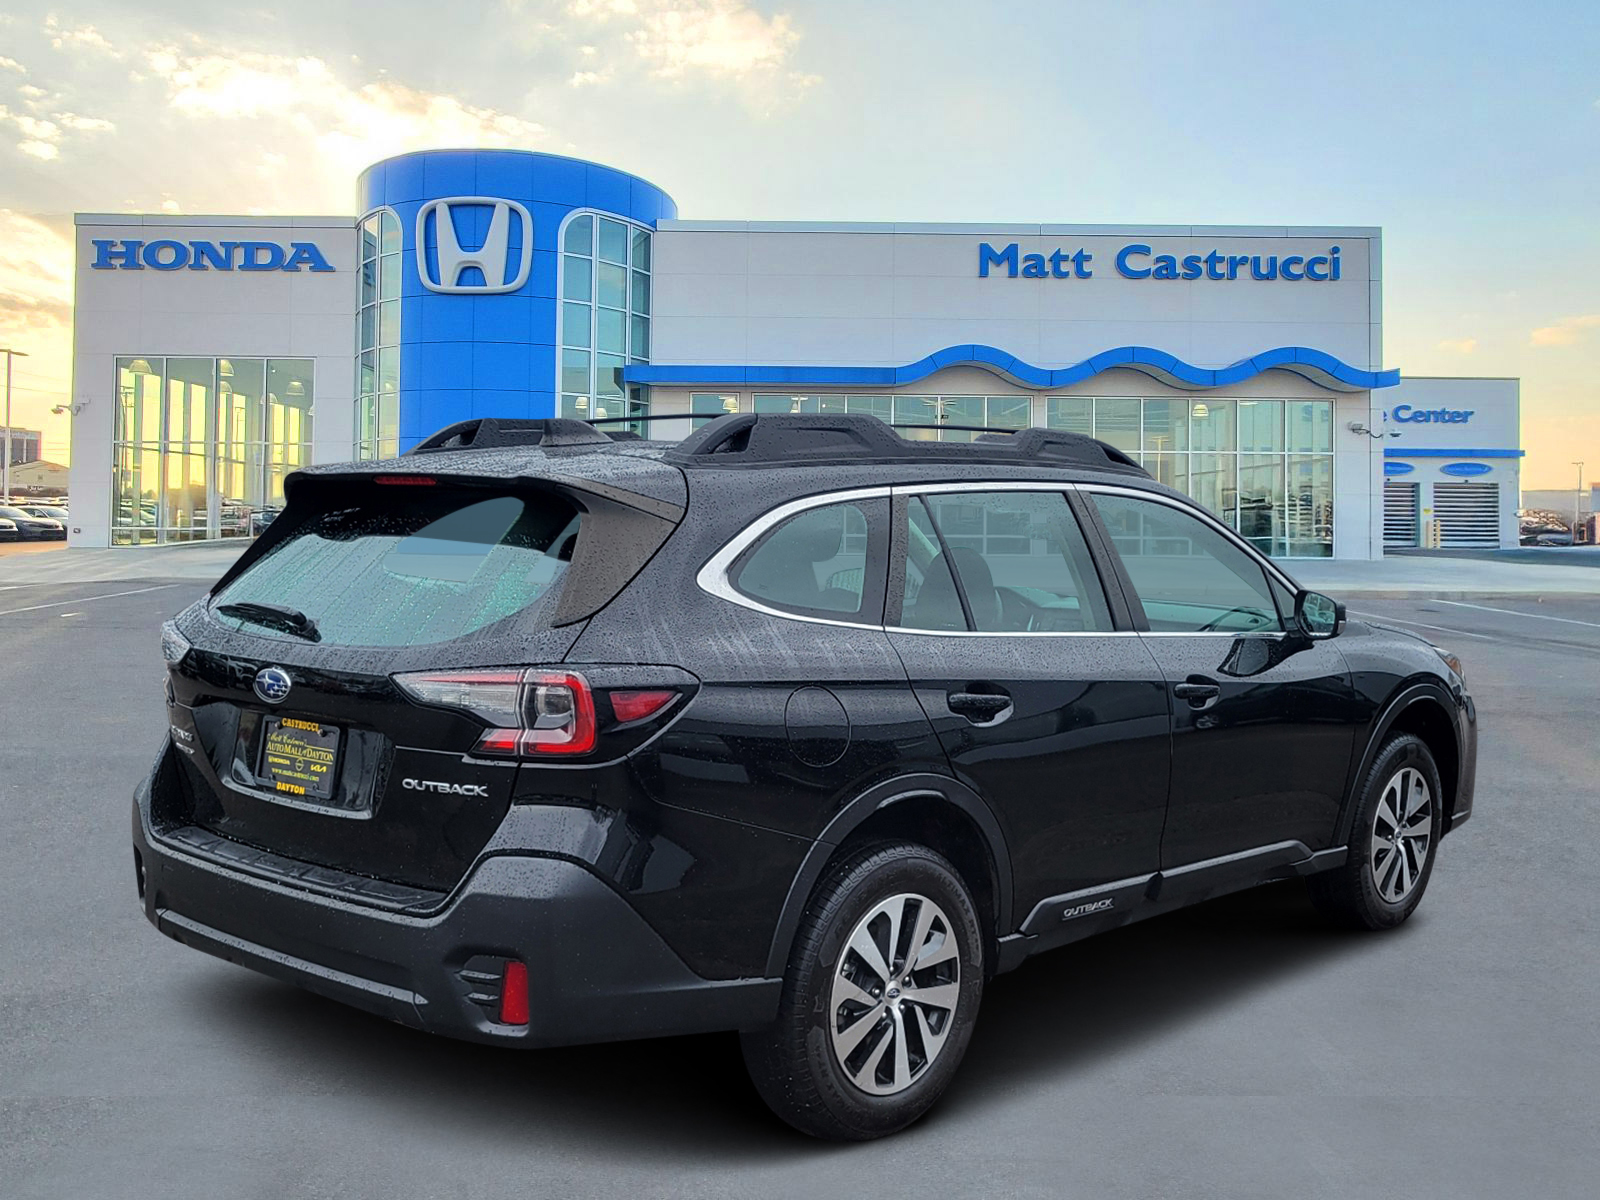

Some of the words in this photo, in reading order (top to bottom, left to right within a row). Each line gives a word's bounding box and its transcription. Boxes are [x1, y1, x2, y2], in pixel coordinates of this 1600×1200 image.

[91, 239, 336, 272] HONDA
[978, 242, 1093, 280] Matt
[1114, 243, 1342, 281] Castrucci
[1392, 404, 1475, 424] Center
[281, 717, 319, 732] CASTRUCCI
[307, 748, 334, 761] DAYTON
[276, 781, 305, 795] DAYTON
[402, 778, 489, 797] OUTBACK
[1063, 897, 1114, 918] OUTBACK
